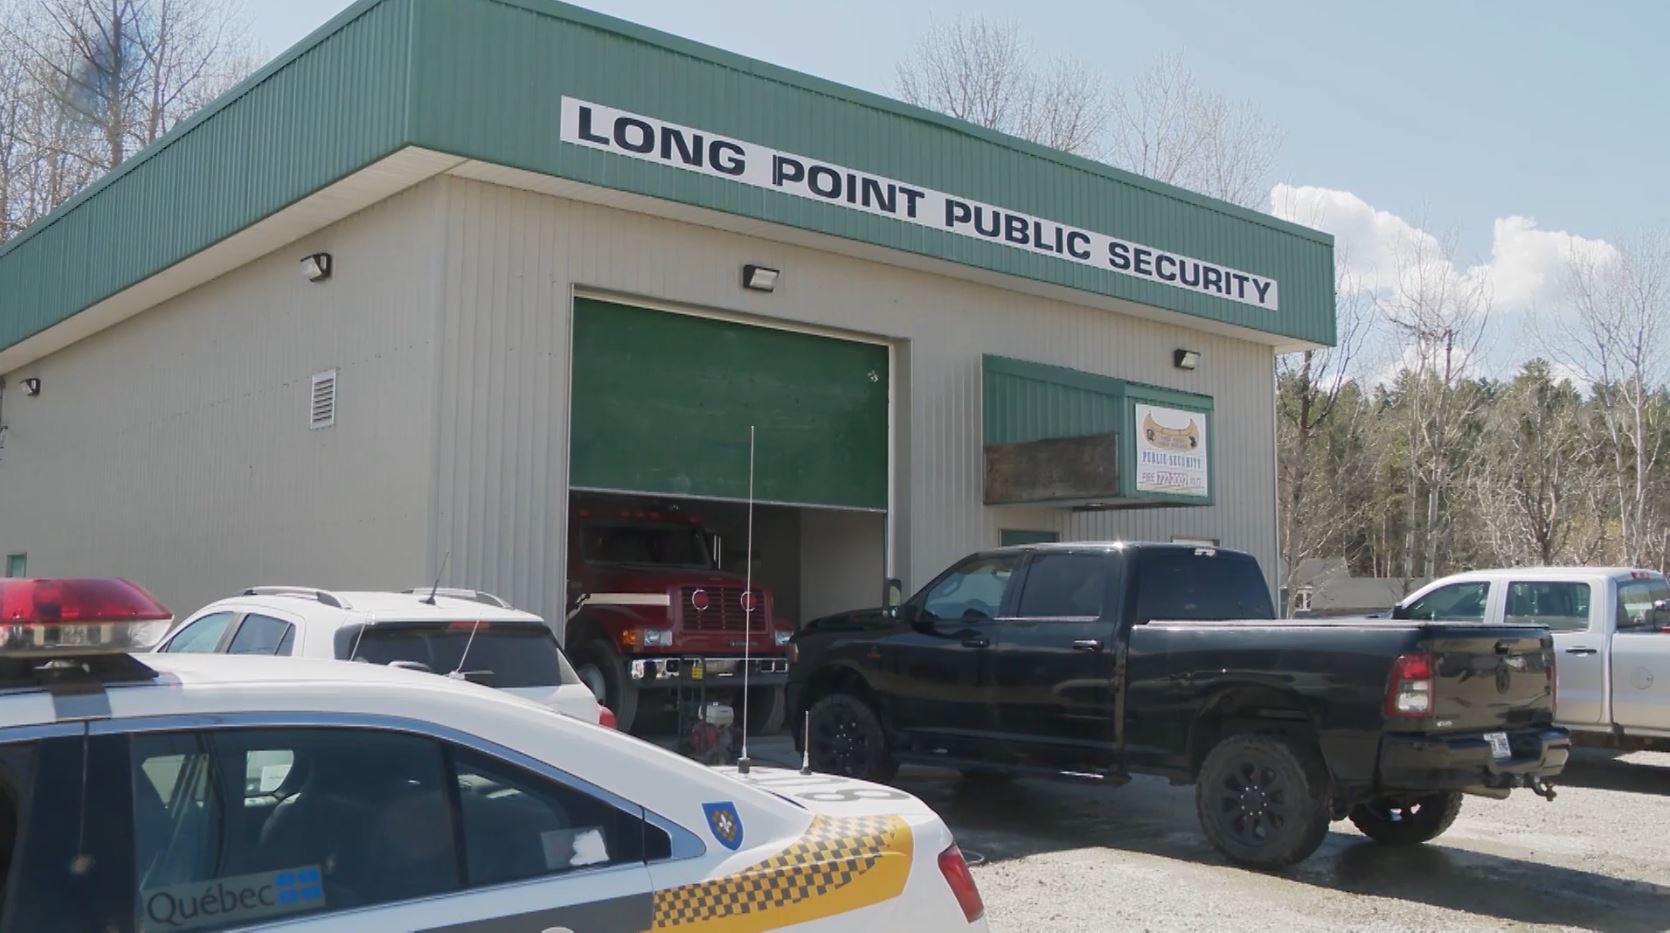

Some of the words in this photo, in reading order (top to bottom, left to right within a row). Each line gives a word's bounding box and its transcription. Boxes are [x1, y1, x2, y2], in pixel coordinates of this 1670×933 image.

[578, 105, 746, 176] LONG
[772, 154, 925, 218] POINT
[945, 198, 1091, 260] PUBLIC
[1108, 241, 1271, 304] SECURITY
[1142, 451, 1167, 465] PUBLIC
[1169, 454, 1201, 469] SECURITY
[147, 883, 275, 926] Québec
